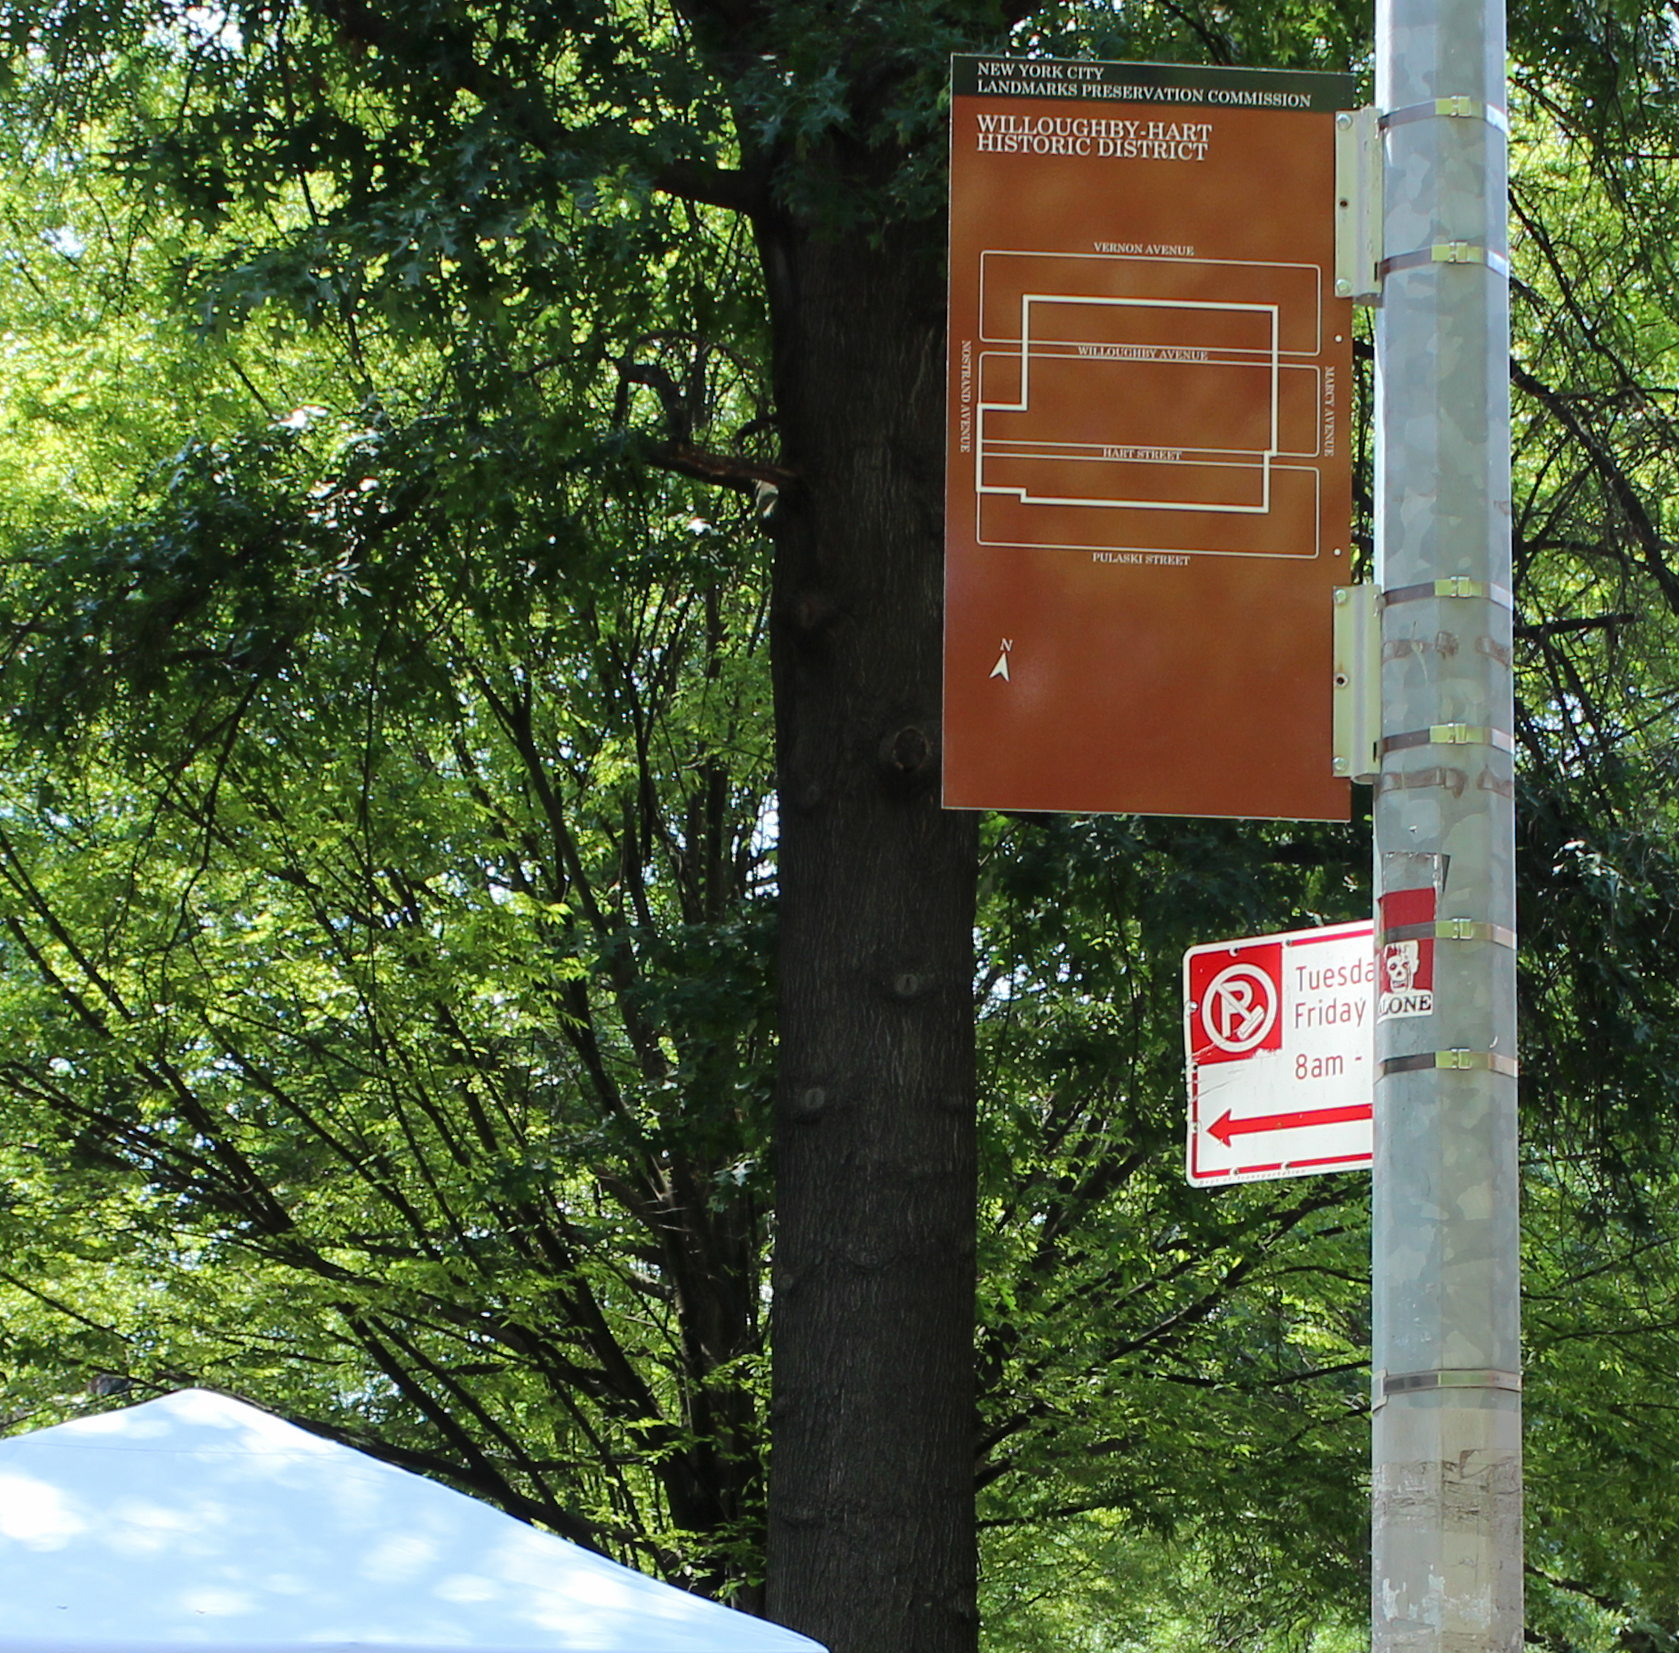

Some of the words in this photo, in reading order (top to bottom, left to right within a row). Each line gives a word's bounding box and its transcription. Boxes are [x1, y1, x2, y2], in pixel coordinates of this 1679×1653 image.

[977, 62, 1015, 77] NEW
[1019, 64, 1063, 79] YORK
[1067, 66, 1104, 81] CITY
[977, 79, 1078, 97] LANDMARKS
[1082, 83, 1204, 102] PRESERVATION
[1208, 89, 1312, 108] COMMISSION
[976, 114, 1213, 142] WILLOUGHBY-HART
[977, 133, 1091, 156] HISTORIC
[1097, 138, 1209, 161] DISTRICT
[1093, 241, 1143, 254] VERNON
[1145, 244, 1195, 256] AVENUE
[1077, 345, 1158, 359] WILLOUGHBY
[1160, 349, 1209, 361] AVENUE
[961, 340, 972, 403] NOSTRAND
[1324, 366, 1335, 407] MARCY
[960, 404, 971, 453] AVENUE
[1324, 407, 1335, 457] AVENUE
[1103, 447, 1135, 459] HART
[1137, 449, 1183, 461] STREET
[1092, 552, 1143, 564] PULASKI
[1145, 554, 1191, 566] STREET
[1000, 637, 1013, 652] N
[1295, 956, 1375, 992] Tuesda
[1294, 997, 1367, 1029] Friday
[1294, 1053, 1344, 1080] 8am
